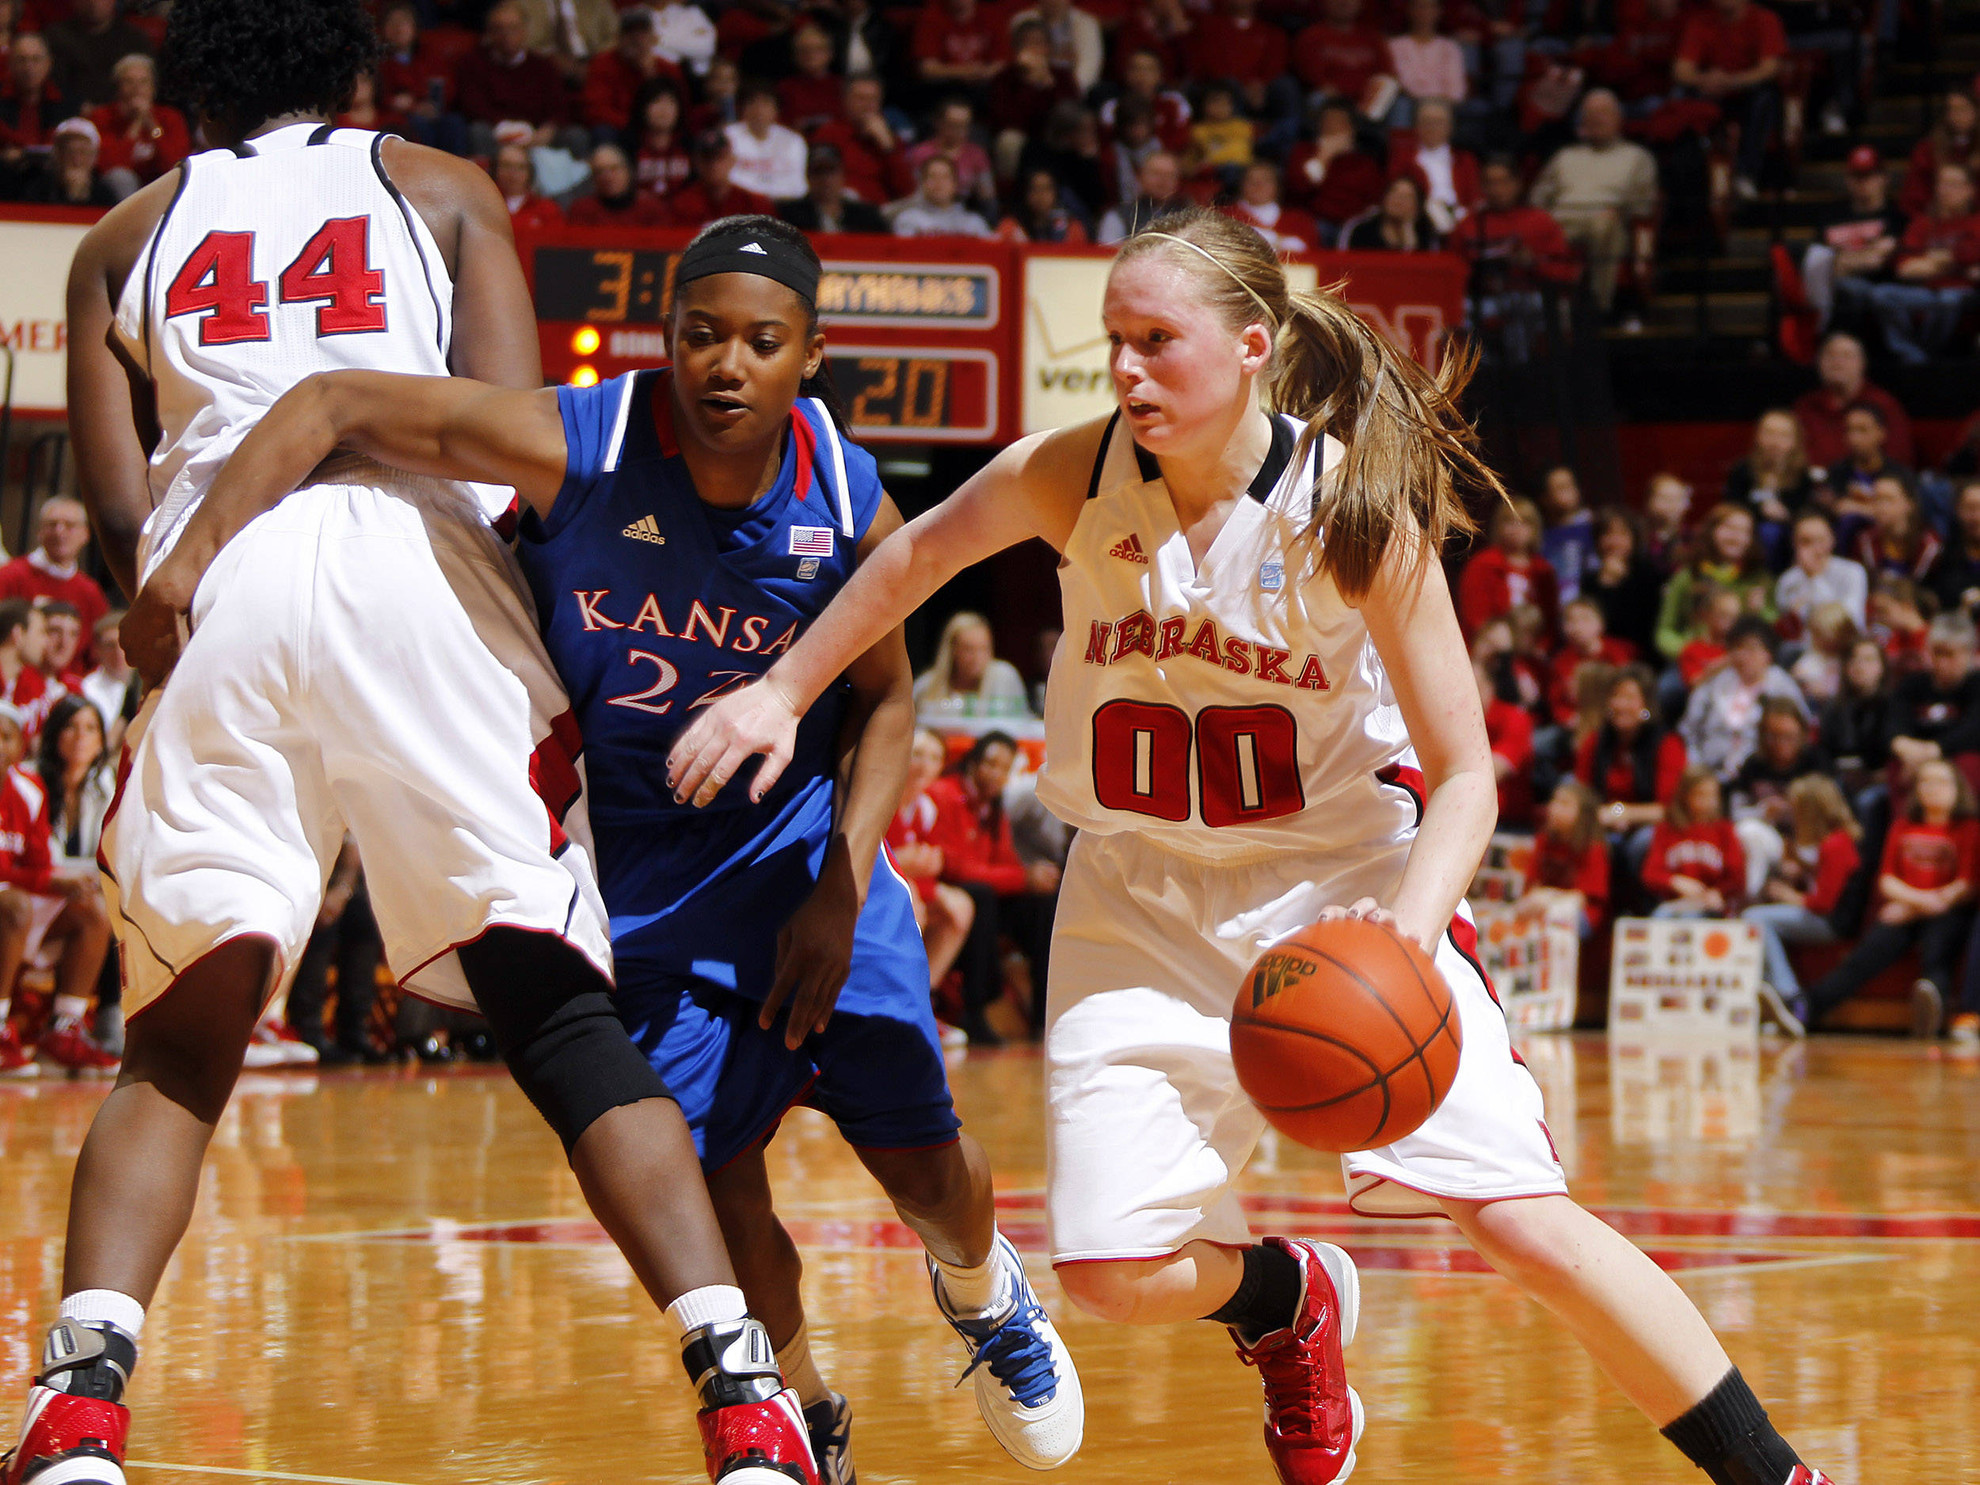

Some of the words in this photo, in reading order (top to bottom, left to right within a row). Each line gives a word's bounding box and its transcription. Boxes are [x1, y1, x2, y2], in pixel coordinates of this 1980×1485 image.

[166, 214, 388, 346] 44
[851, 357, 948, 428] 20
[622, 526, 665, 545] adidas
[1109, 547, 1149, 565] adidas
[1084, 609, 1331, 691] NEBRASKA
[1092, 698, 1306, 828] 00
